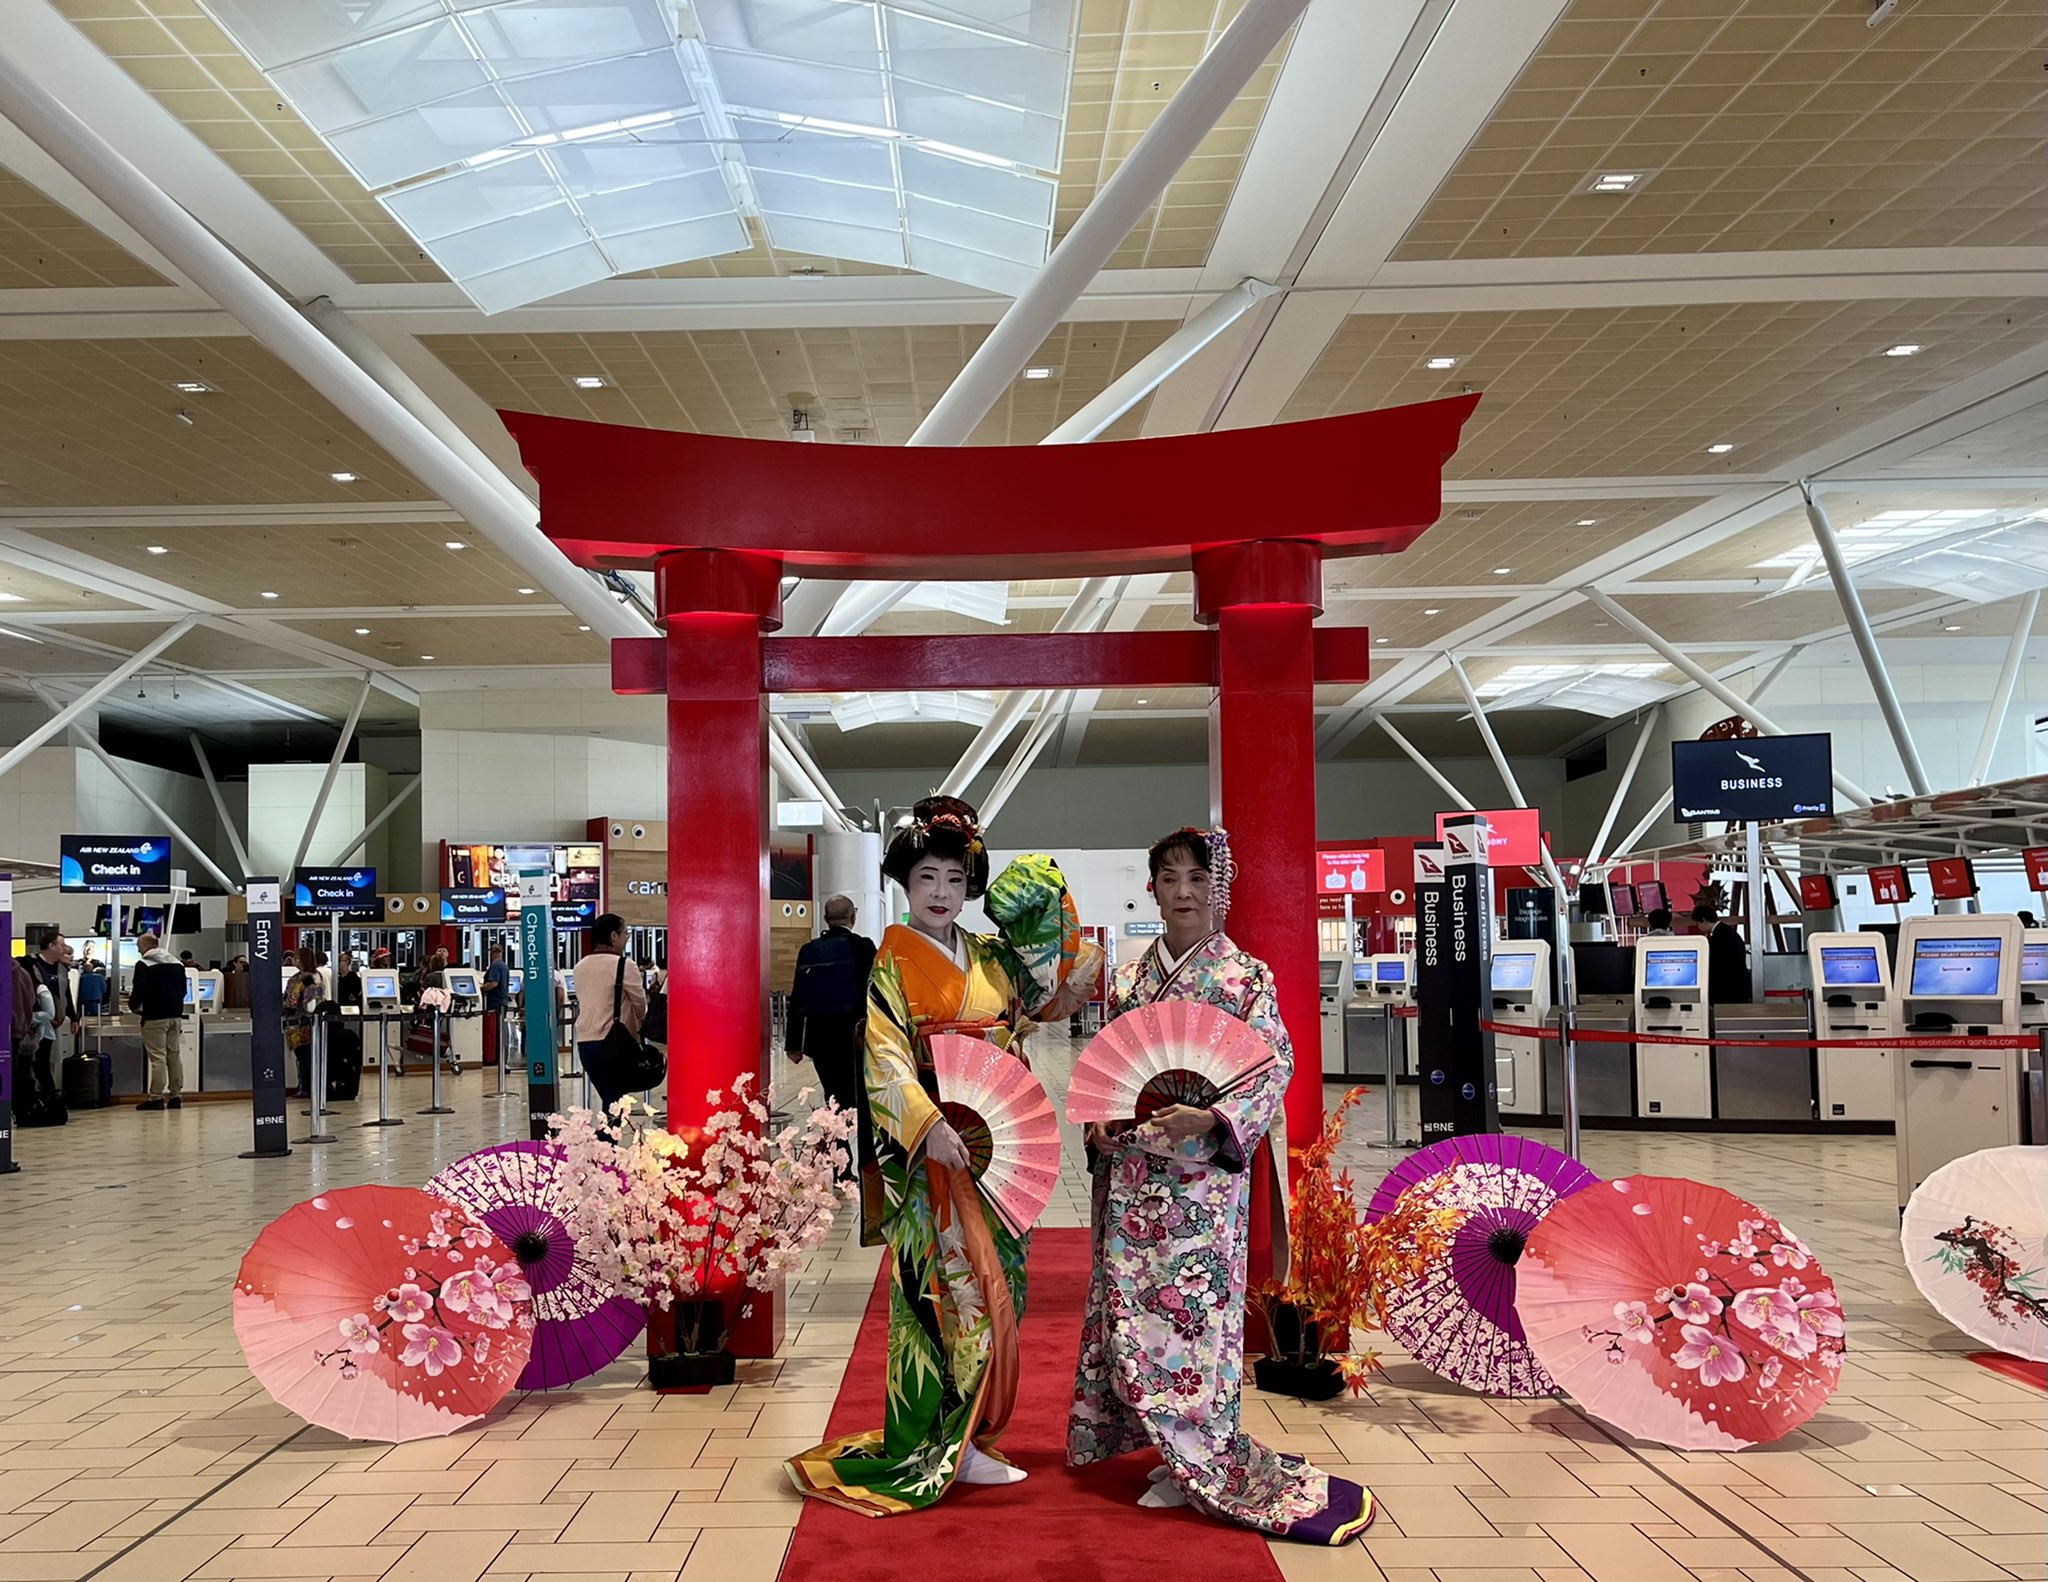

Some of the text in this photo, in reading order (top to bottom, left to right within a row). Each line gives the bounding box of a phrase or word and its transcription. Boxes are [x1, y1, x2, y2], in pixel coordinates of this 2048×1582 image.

[1720, 777, 1783, 790] BUSINESS
[1802, 804, 1819, 812] Priority
[91, 864, 141, 875] Check in
[317, 889, 354, 897] Check in
[1452, 874, 1468, 962] Business
[1424, 891, 1440, 966] Business
[254, 919, 271, 960] Entry
[526, 912, 540, 980] Check-in
[1879, 1040, 1898, 1048] your
[1899, 1039, 1916, 1047] first
[1917, 1038, 1966, 1047] destination
[1967, 1038, 2018, 1047] qantas.com
[264, 1115, 285, 1125] BNE
[1433, 1122, 1455, 1132] BNE
